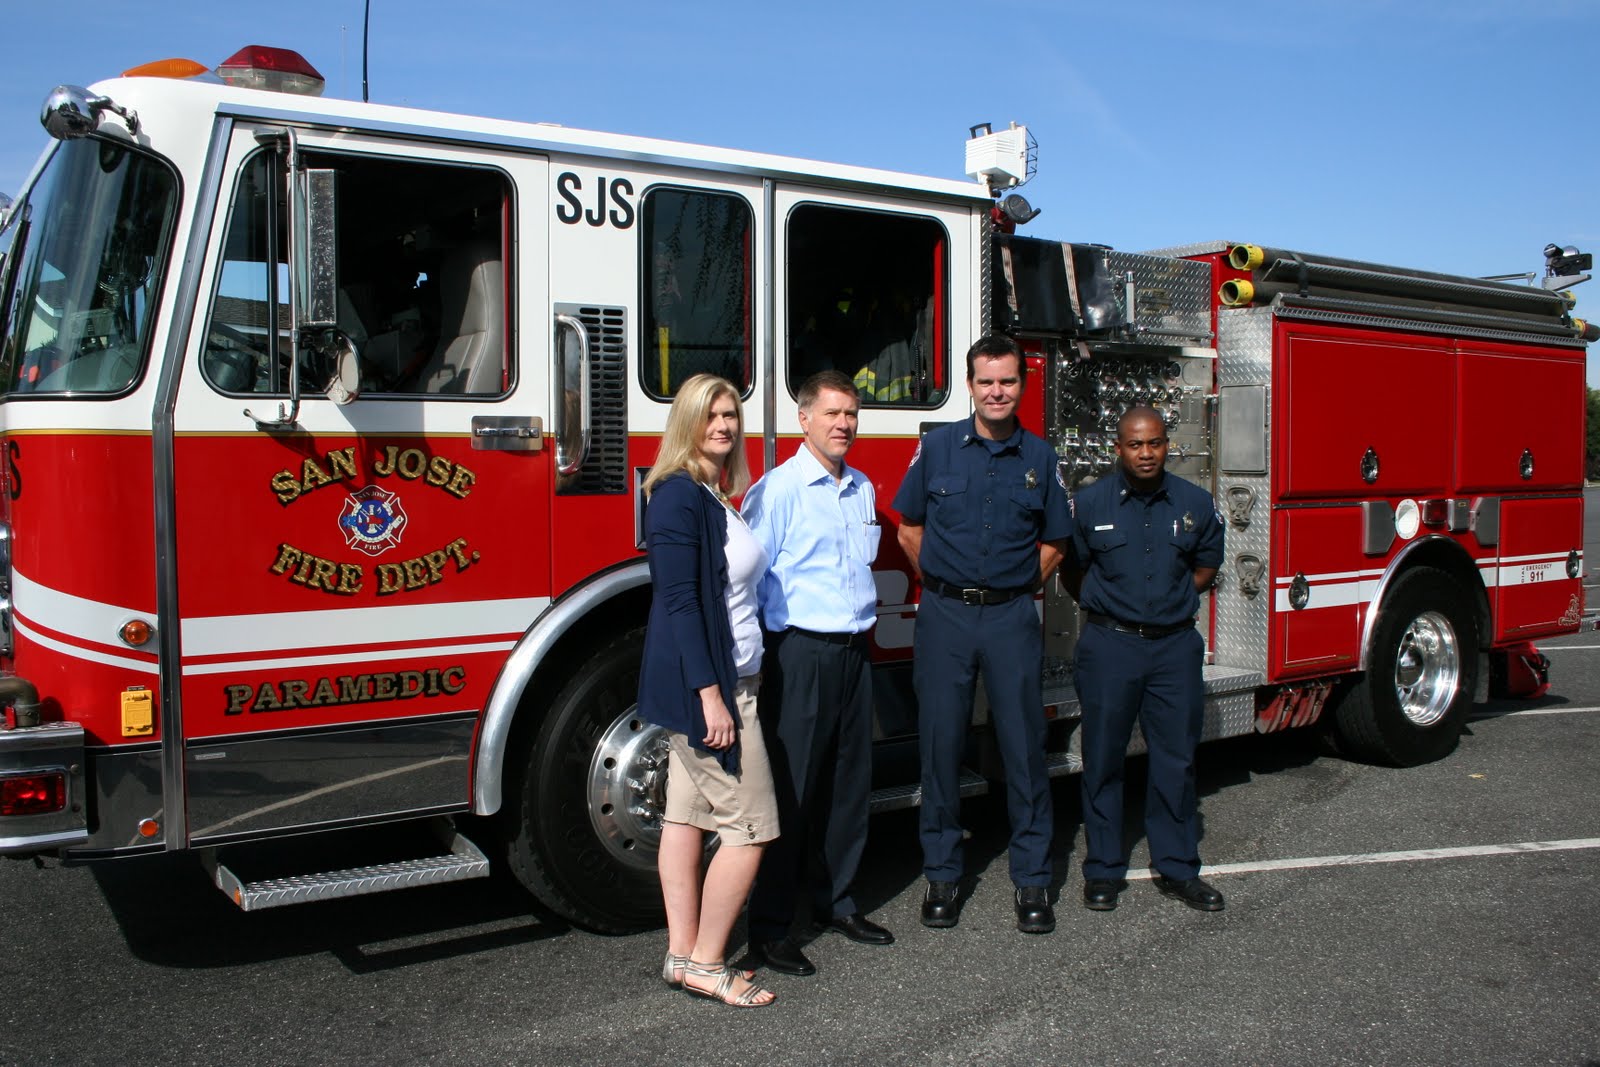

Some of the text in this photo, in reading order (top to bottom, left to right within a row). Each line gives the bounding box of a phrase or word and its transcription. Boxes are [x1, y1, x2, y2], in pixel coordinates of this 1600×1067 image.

[556, 171, 635, 230] SJS
[270, 446, 477, 505] SAN JOSE
[270, 537, 481, 596] FIRE DEPT.
[1530, 571, 1544, 582] 911
[225, 666, 467, 716] PARAMEDIC
